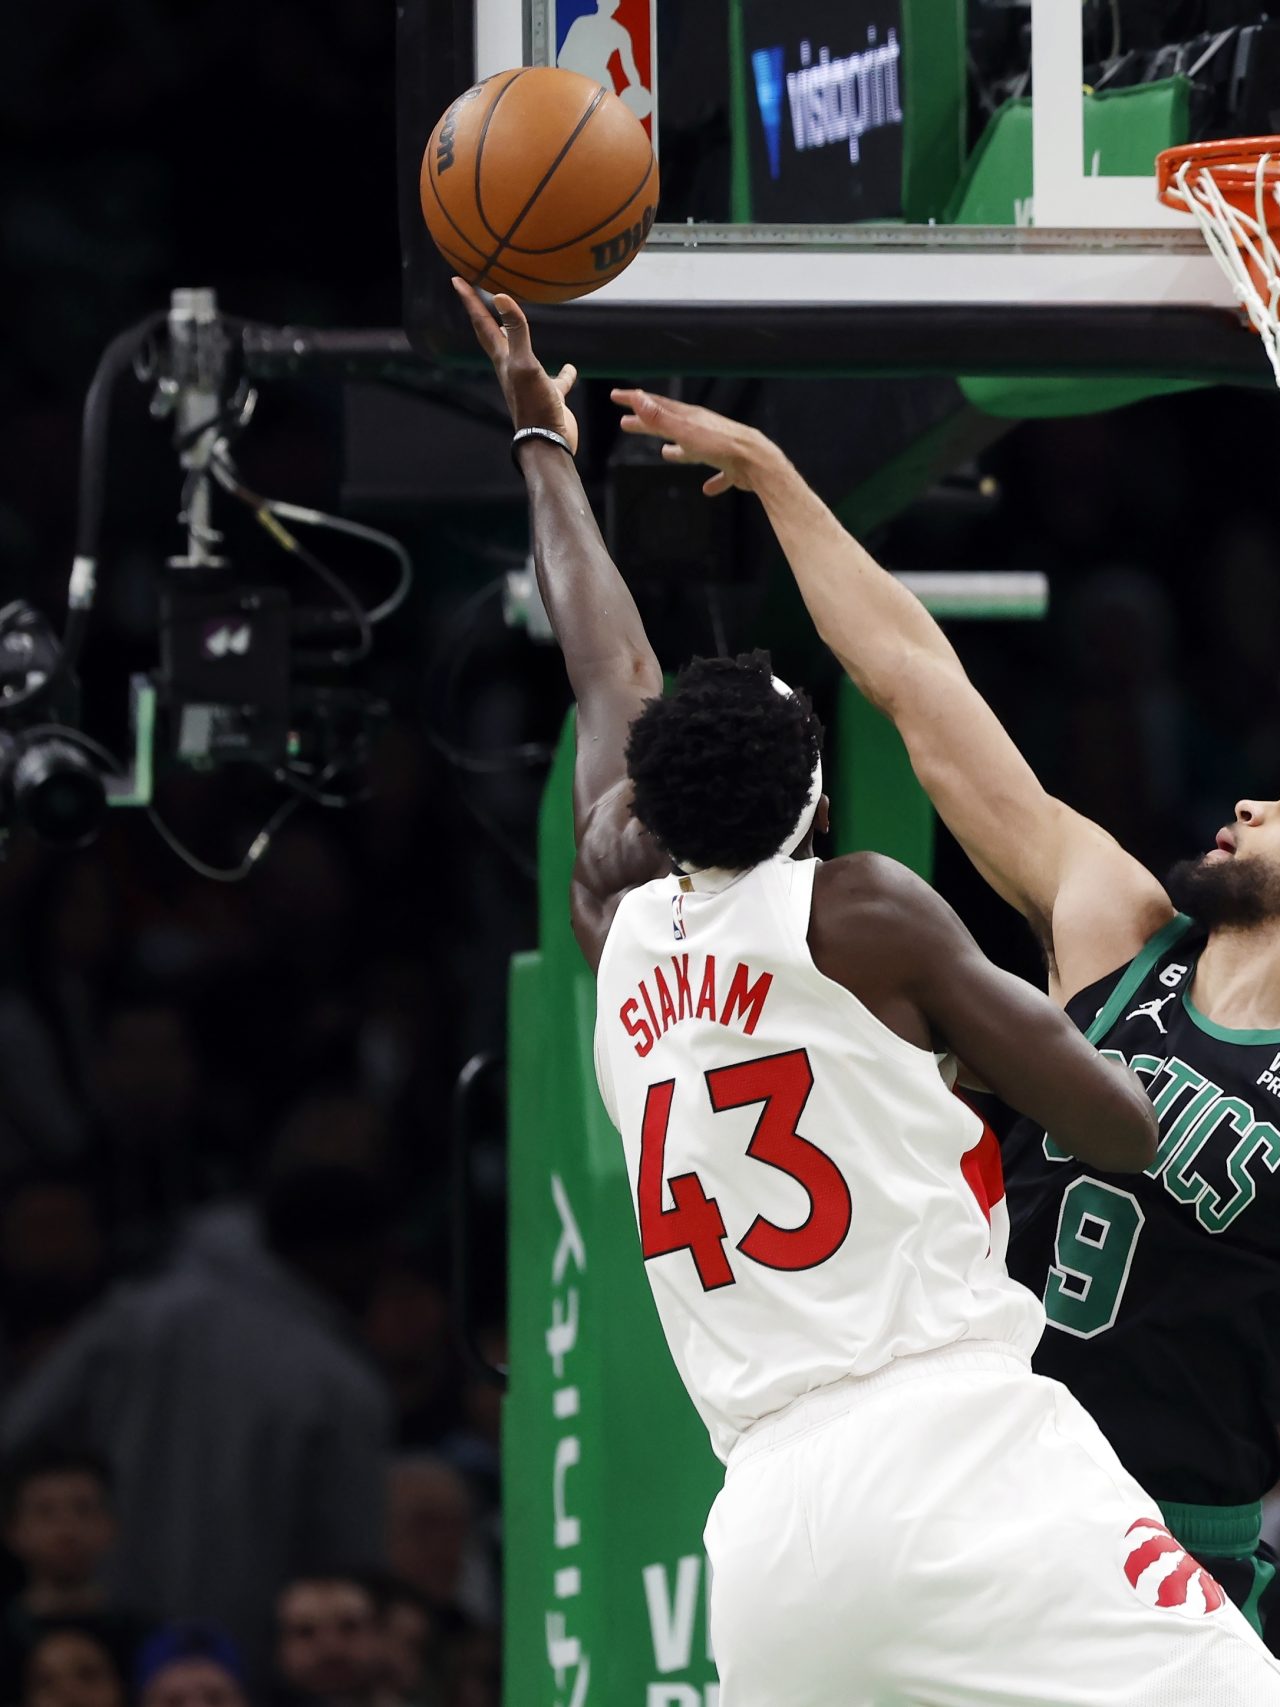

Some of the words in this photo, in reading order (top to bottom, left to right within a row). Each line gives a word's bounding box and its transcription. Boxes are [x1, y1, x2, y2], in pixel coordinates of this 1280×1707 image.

[619, 953, 774, 1058] SIAKAM
[1158, 962, 1188, 988] 6
[637, 1047, 852, 1293] 43
[1042, 1174, 1146, 1340] 9
